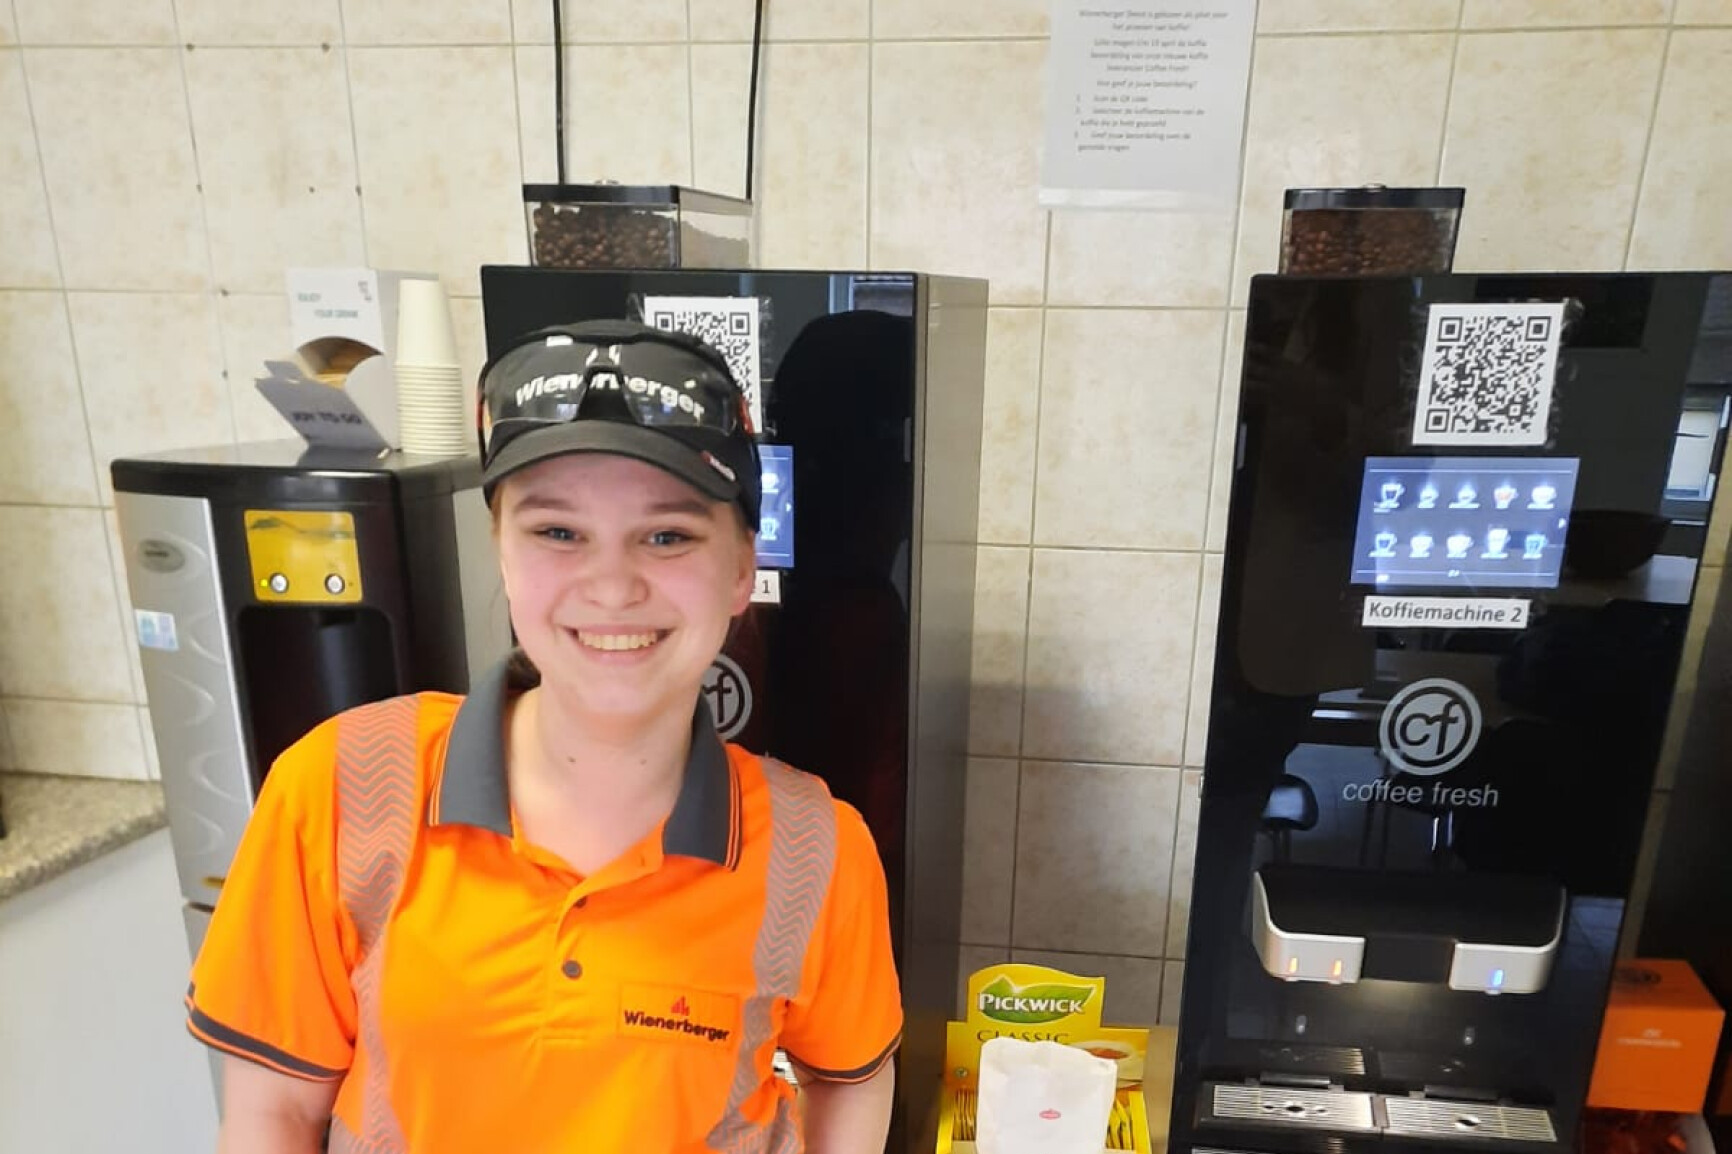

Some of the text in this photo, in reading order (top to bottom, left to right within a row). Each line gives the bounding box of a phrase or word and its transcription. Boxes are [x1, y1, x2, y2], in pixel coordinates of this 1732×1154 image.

[762, 579, 770, 594] 1
[1369, 602, 1522, 623] Koffiemachine 2
[1343, 778, 1499, 807] coffee fresh
[979, 992, 1083, 1014] PICKWICK
[623, 1009, 730, 1042] Wienerberger
